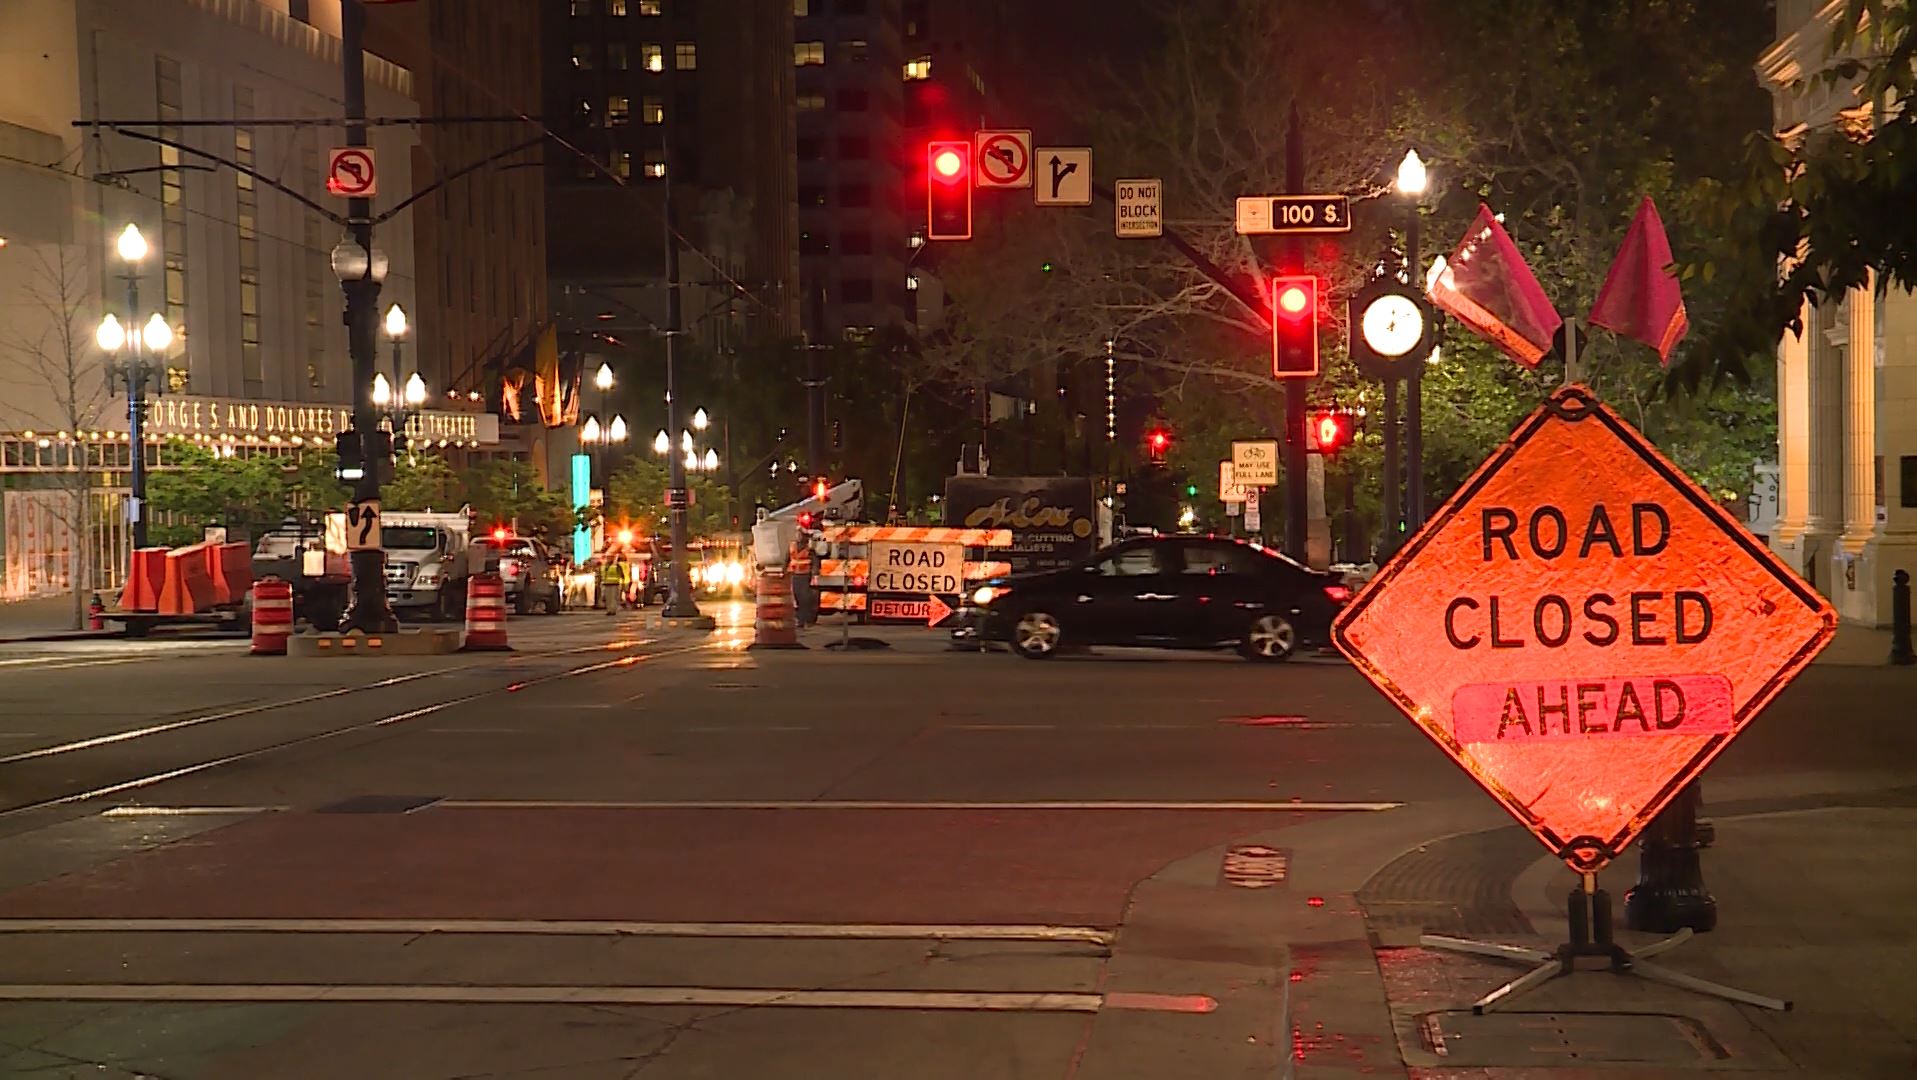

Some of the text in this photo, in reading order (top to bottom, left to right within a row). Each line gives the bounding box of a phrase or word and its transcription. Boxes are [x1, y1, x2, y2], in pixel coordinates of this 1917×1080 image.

[1120, 186, 1157, 200] DO NOT
[1120, 205, 1158, 218] BLOCK
[1281, 204, 1315, 224] 100
[1324, 203, 1341, 224] S.
[142, 398, 201, 430] ORGE
[228, 404, 259, 432] AND
[266, 405, 333, 434] DOLORES
[429, 414, 475, 438] THEATER
[1027, 532, 1075, 543] CUTTING
[1482, 501, 1672, 562] ROAD
[889, 548, 946, 569] ROAD
[876, 572, 957, 592] CLOSED
[873, 602, 931, 616] DETOUR
[1444, 590, 1714, 650] CLOSED
[1496, 679, 1687, 740] AHEAD
